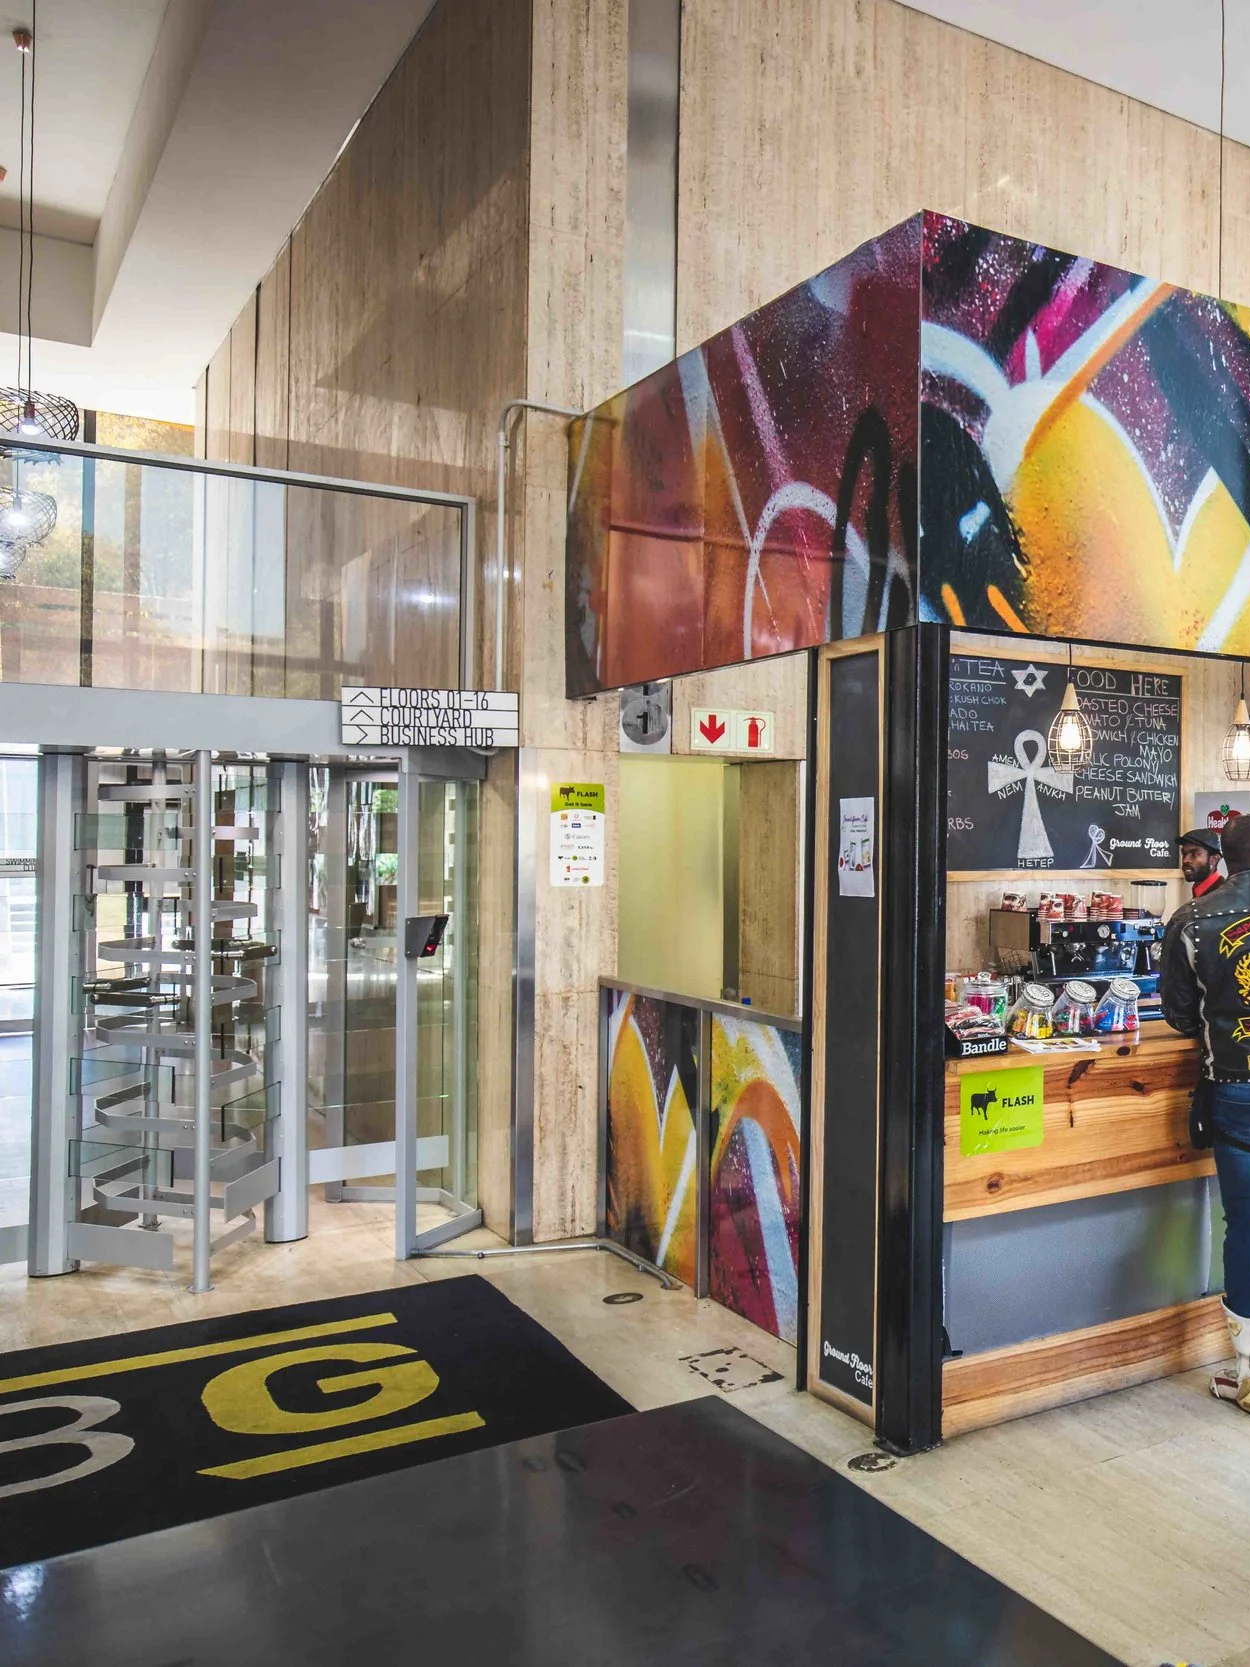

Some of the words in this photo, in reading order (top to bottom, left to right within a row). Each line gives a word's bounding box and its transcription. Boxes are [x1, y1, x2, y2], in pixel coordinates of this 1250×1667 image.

[959, 658, 1004, 678] TEA
[1131, 673, 1169, 697] HERE
[380, 687, 440, 709] FLOORS
[1077, 697, 1129, 715] OASTED
[380, 706, 472, 728] COURTYARD
[1085, 713, 1121, 728] MATO
[1135, 717, 1167, 731] TUNA
[380, 725, 457, 746] BUSINESS
[464, 727, 494, 747] HUB
[1091, 729, 1128, 744] DWICH
[1137, 731, 1179, 746] CHICKEN
[1140, 745, 1172, 764] MAYO
[997, 781, 1023, 800] NEM
[1037, 783, 1066, 801] ANKH
[1075, 786, 1123, 802] PEANUT
[1112, 804, 1141, 820] JAM
[1110, 838, 1142, 850] Ground
[1144, 838, 1169, 849] Floor
[1017, 858, 1055, 868] HETEP
[962, 1038, 1007, 1055] Bandle
[1002, 1095, 1034, 1108] FLASH
[979, 1128, 999, 1137] Making
[823, 1340, 851, 1364] Ground
[850, 1353, 873, 1375] Floor
